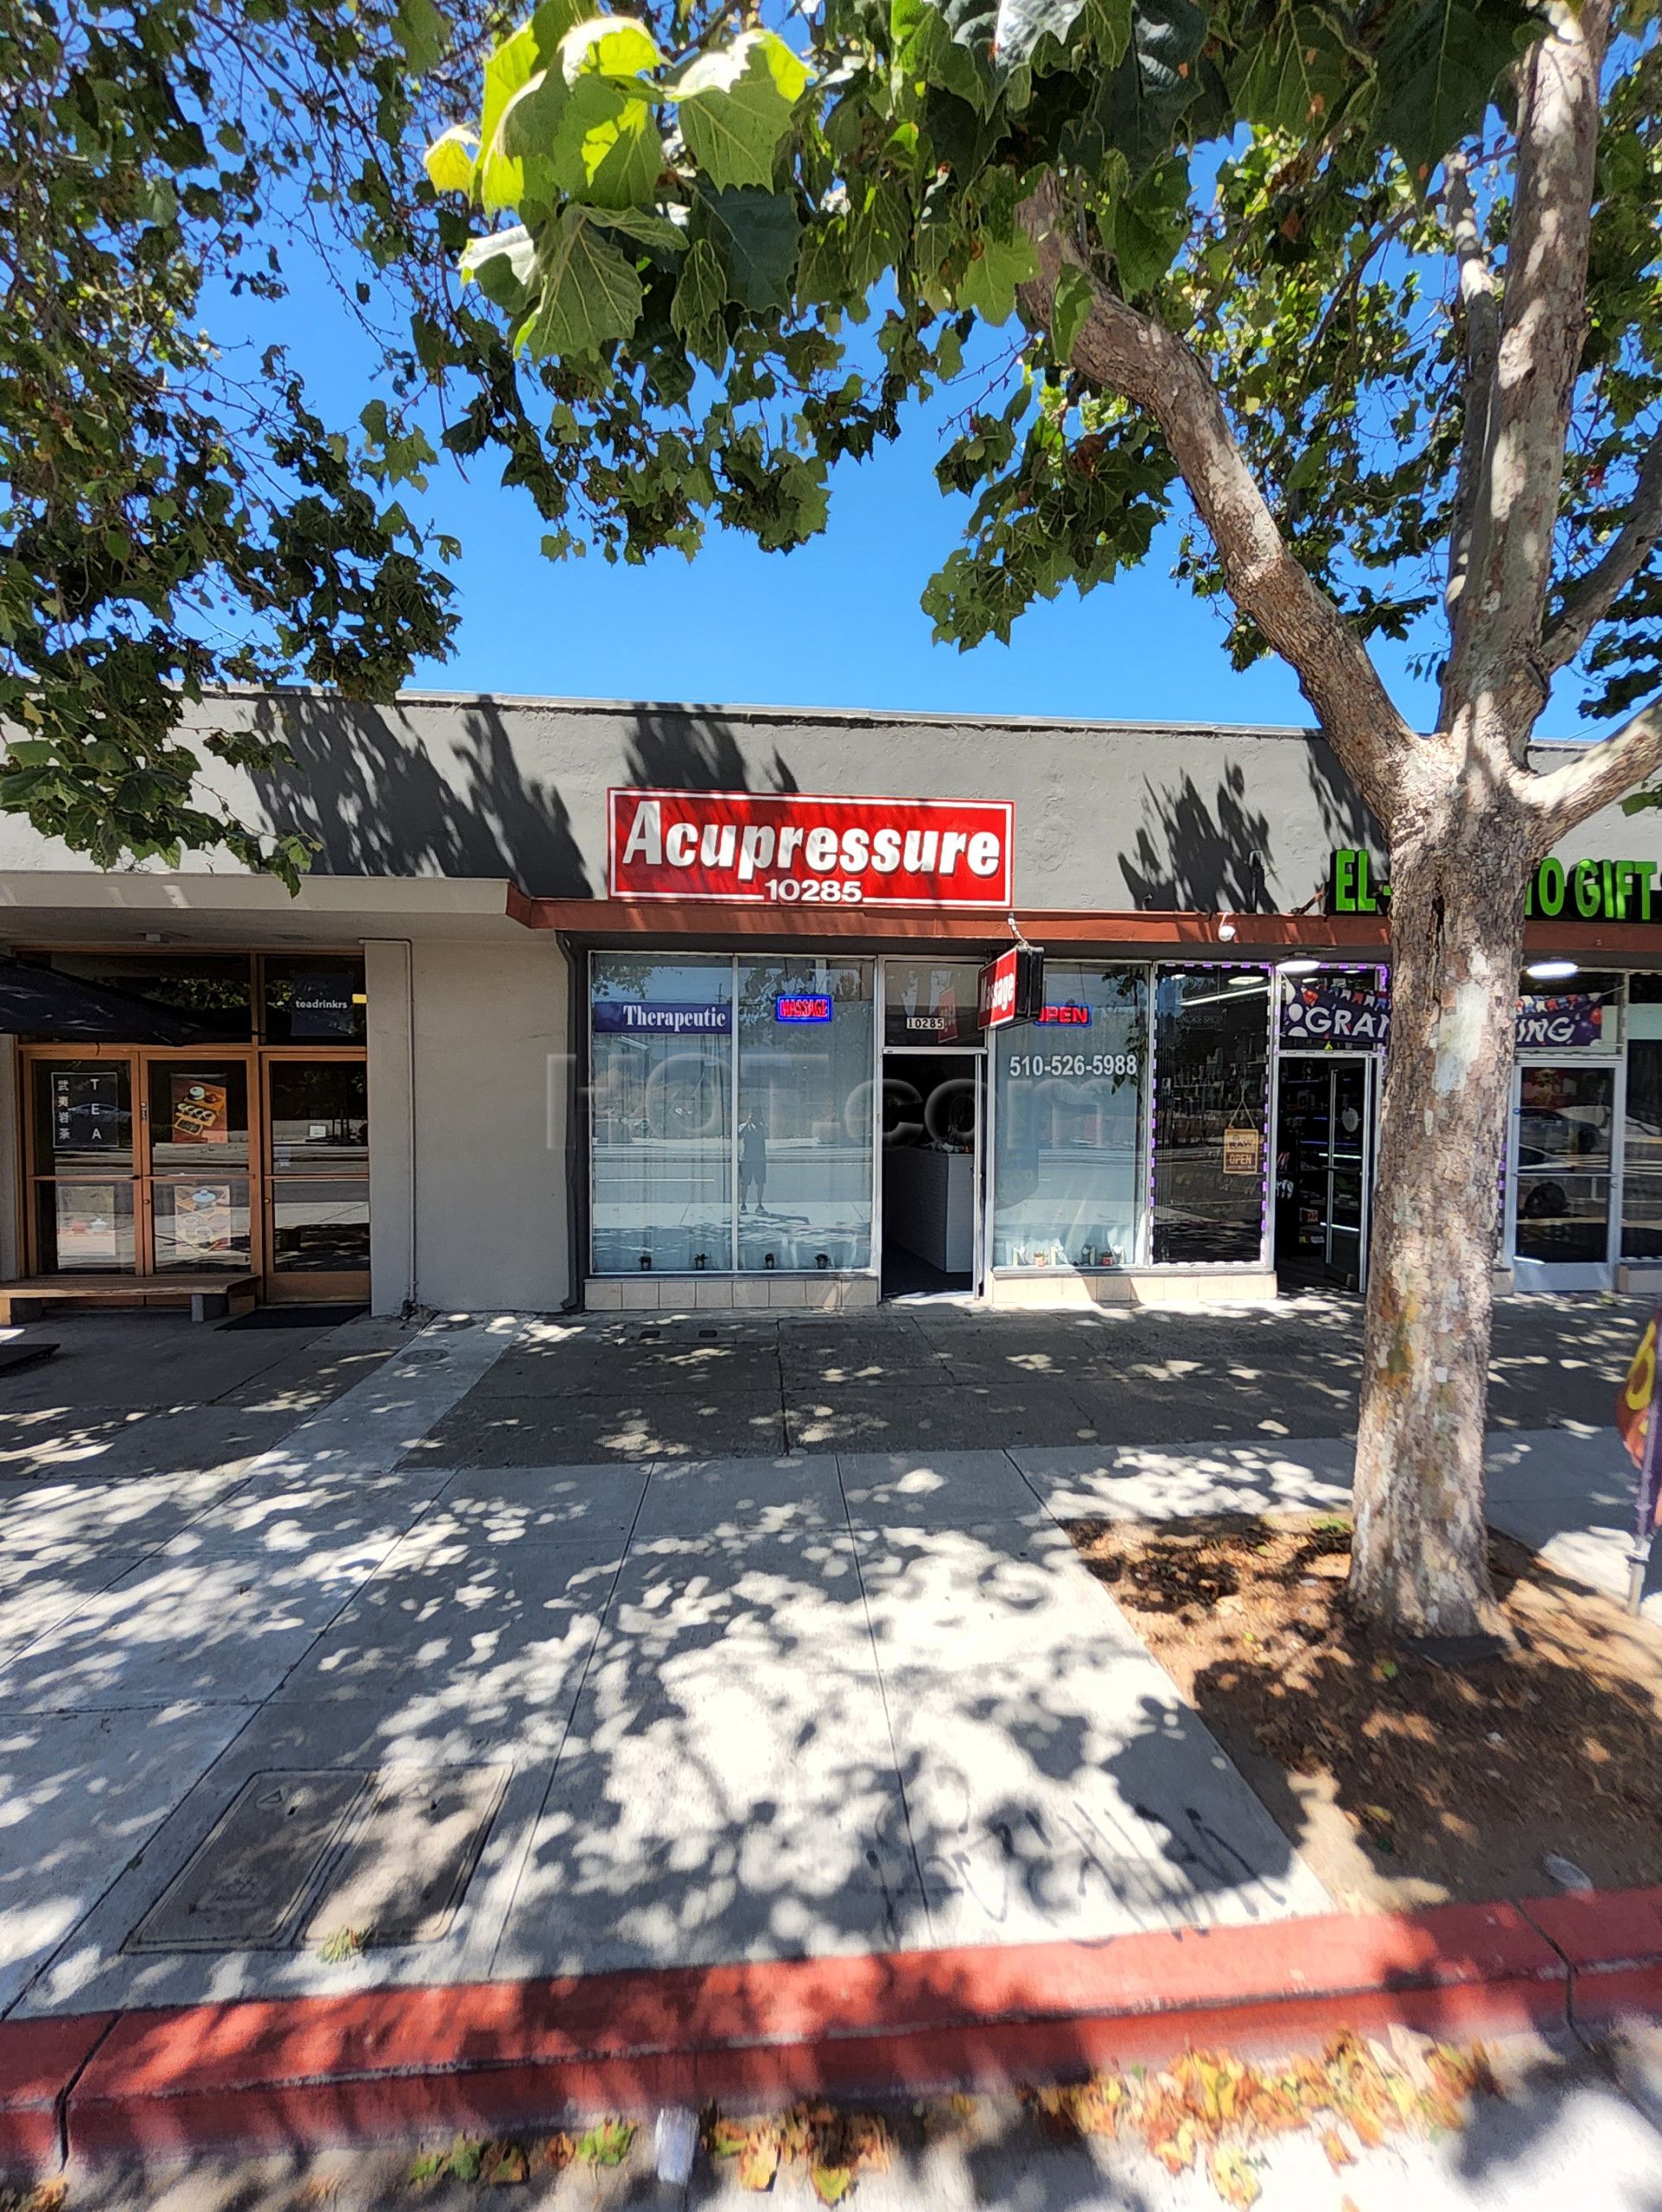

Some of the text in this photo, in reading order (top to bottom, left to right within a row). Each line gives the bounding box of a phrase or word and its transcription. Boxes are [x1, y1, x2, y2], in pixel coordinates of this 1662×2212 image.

[621, 800, 1001, 881] Acupressure
[764, 879, 863, 903] 10285
[1575, 858, 1658, 919] GIFT
[295, 999, 347, 1009] teadrinkrs
[780, 999, 828, 1018] MASSAGE
[622, 1004, 727, 1032] Therapeutic
[908, 1018, 943, 1028] 10285
[1009, 1054, 1137, 1077] 510-526-5988
[90, 1078, 102, 1140] TEA
[1229, 1154, 1252, 1165] OPEN
